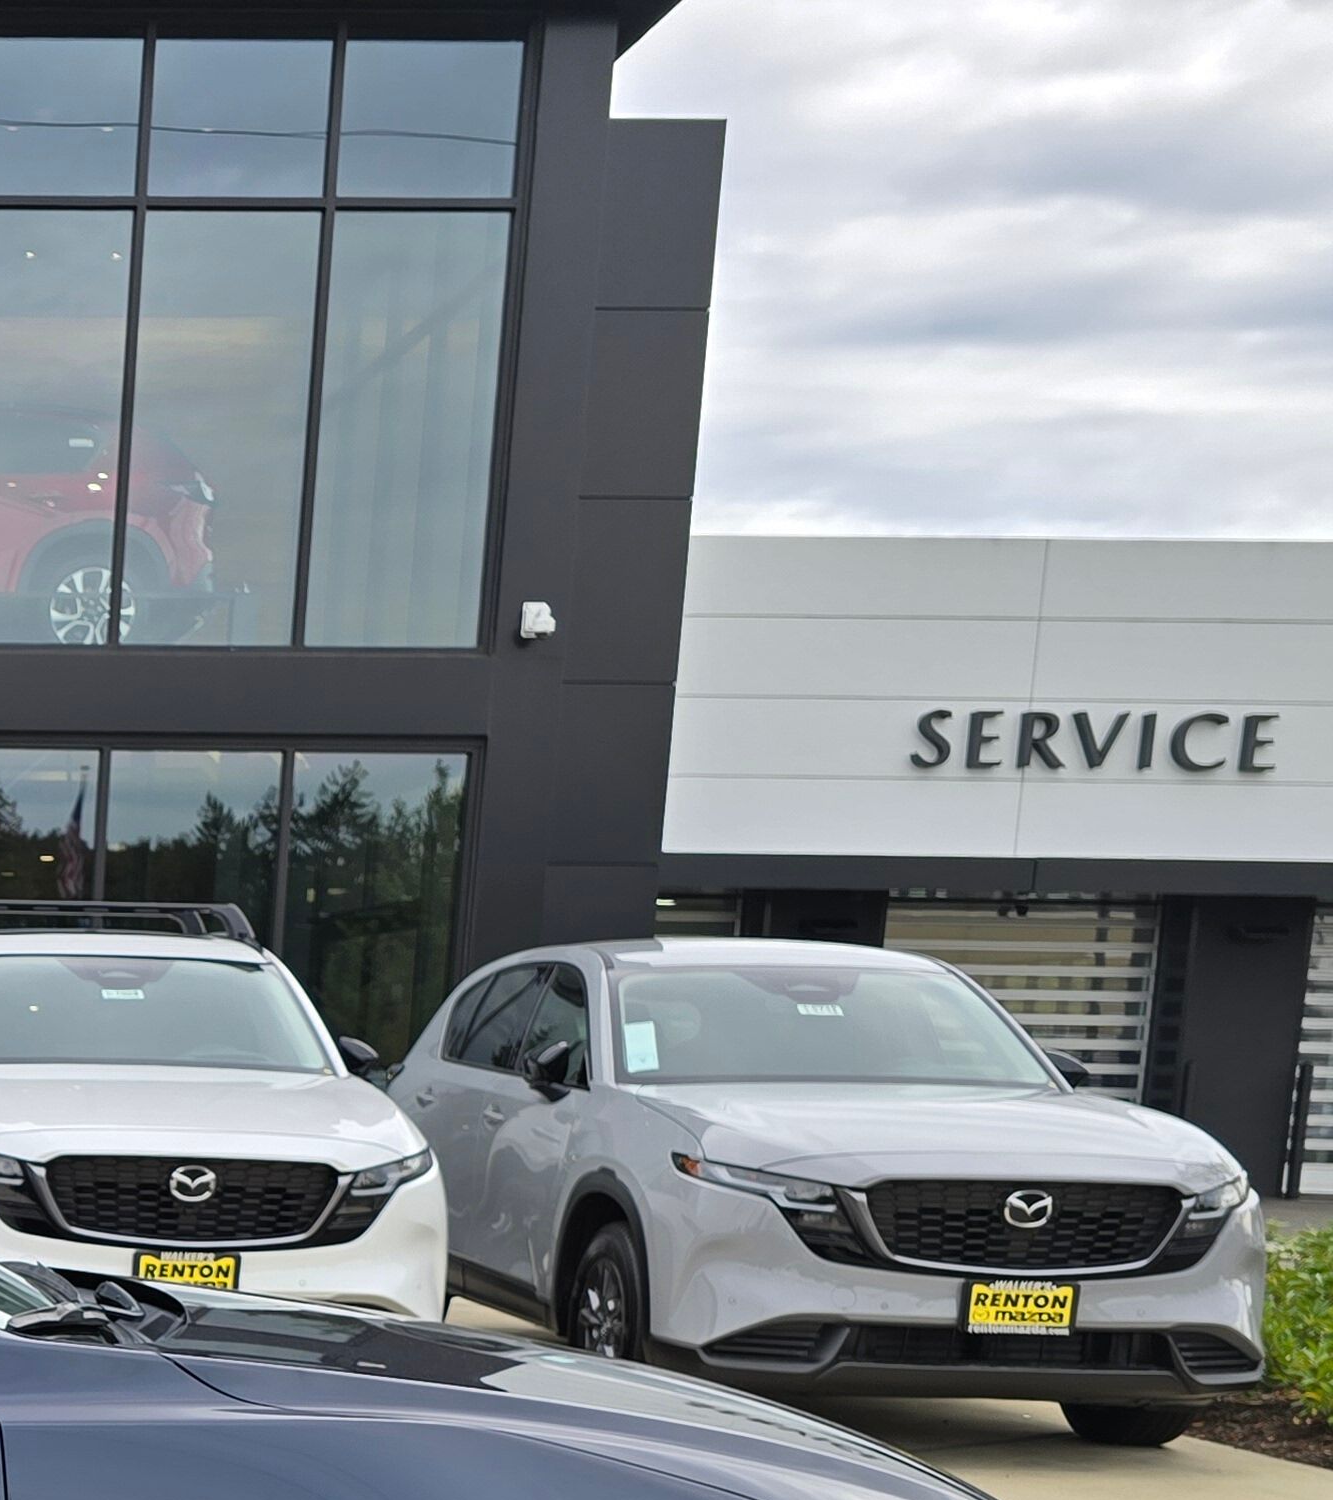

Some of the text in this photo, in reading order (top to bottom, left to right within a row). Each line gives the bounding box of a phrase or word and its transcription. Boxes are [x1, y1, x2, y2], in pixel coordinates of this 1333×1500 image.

[909, 708, 1280, 774] SERVICE
[145, 1263, 231, 1279] RENTON
[994, 1280, 1053, 1291] WALKER'S
[974, 1292, 1068, 1309] RENTON
[994, 1310, 1064, 1323] mazda
